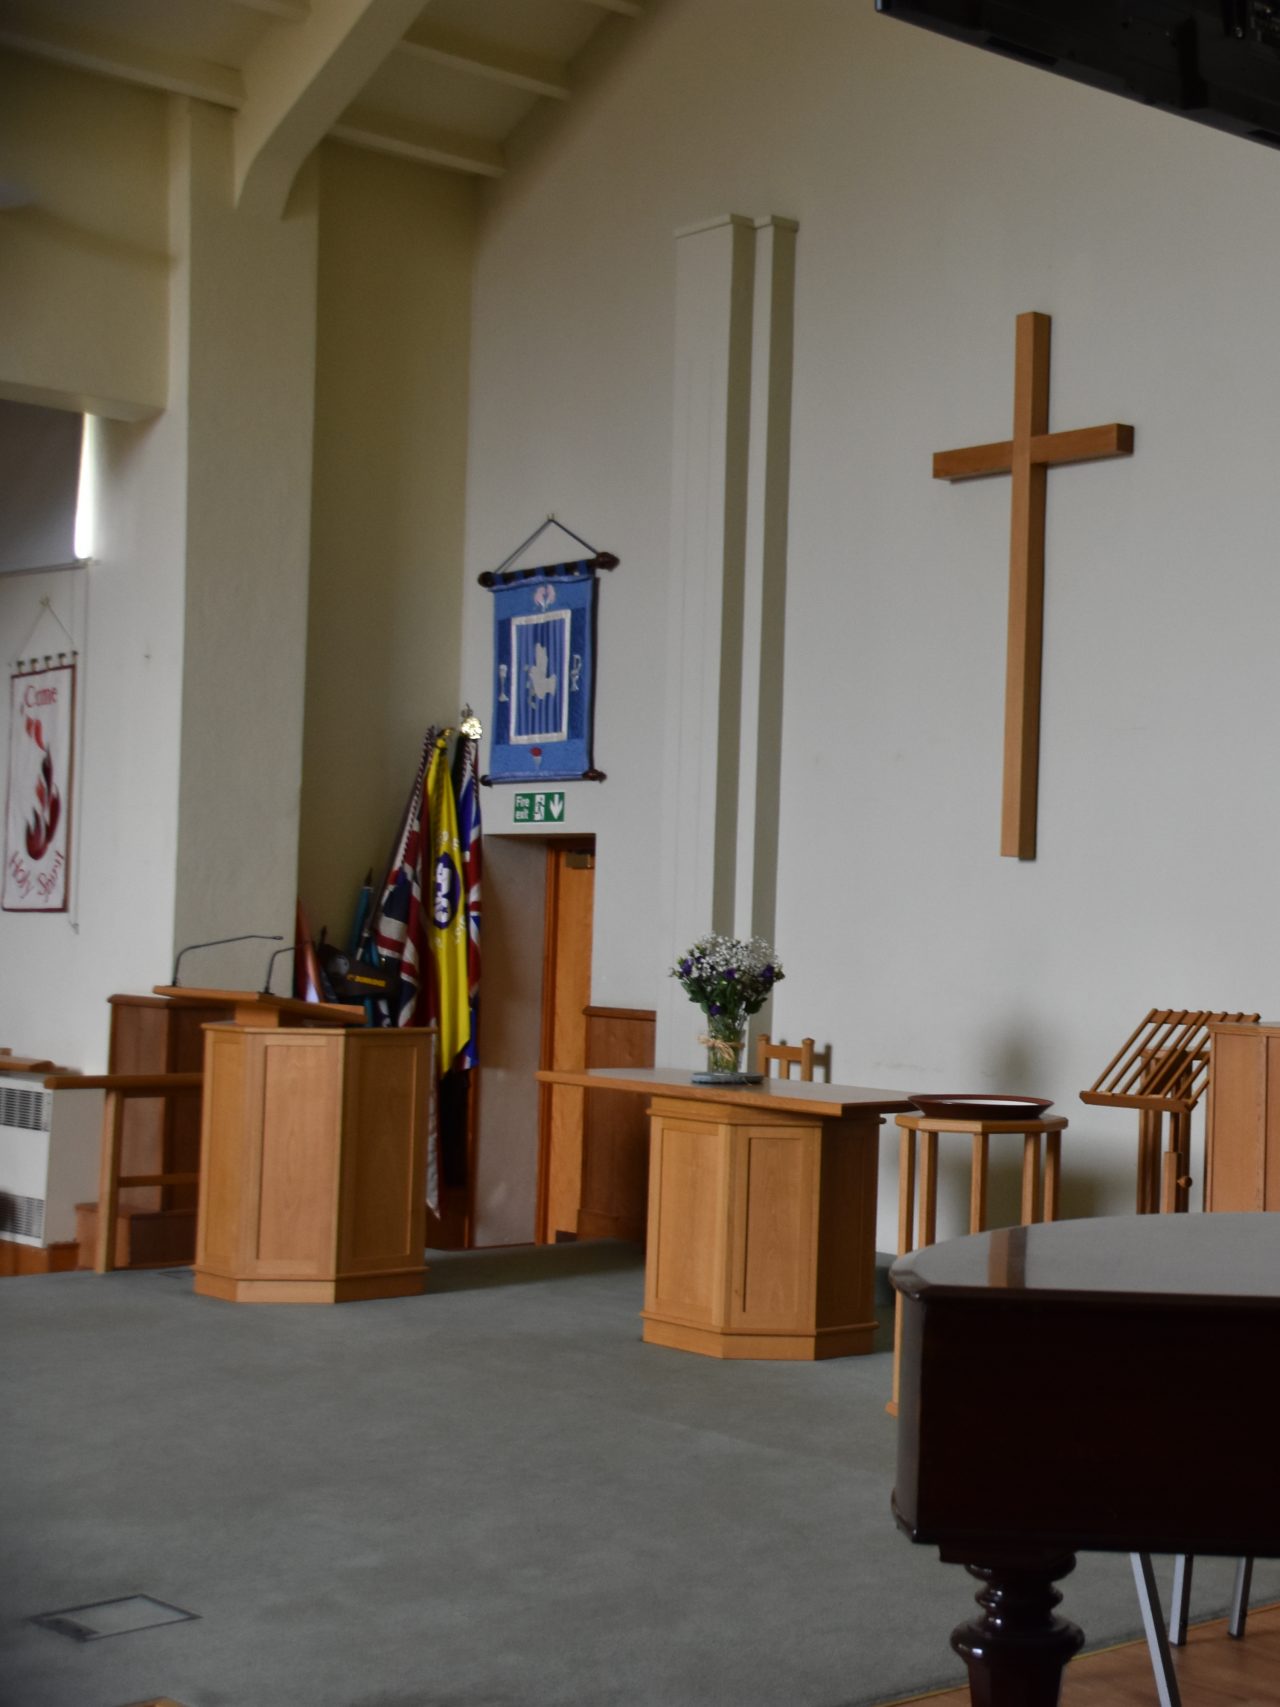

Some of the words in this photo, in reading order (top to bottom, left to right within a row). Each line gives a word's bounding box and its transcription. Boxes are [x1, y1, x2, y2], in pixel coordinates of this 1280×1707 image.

[516, 796, 530, 808] Fire
[515, 809, 529, 820] exit
[9, 851, 34, 899] Holy
[37, 850, 64, 903] Spirit
